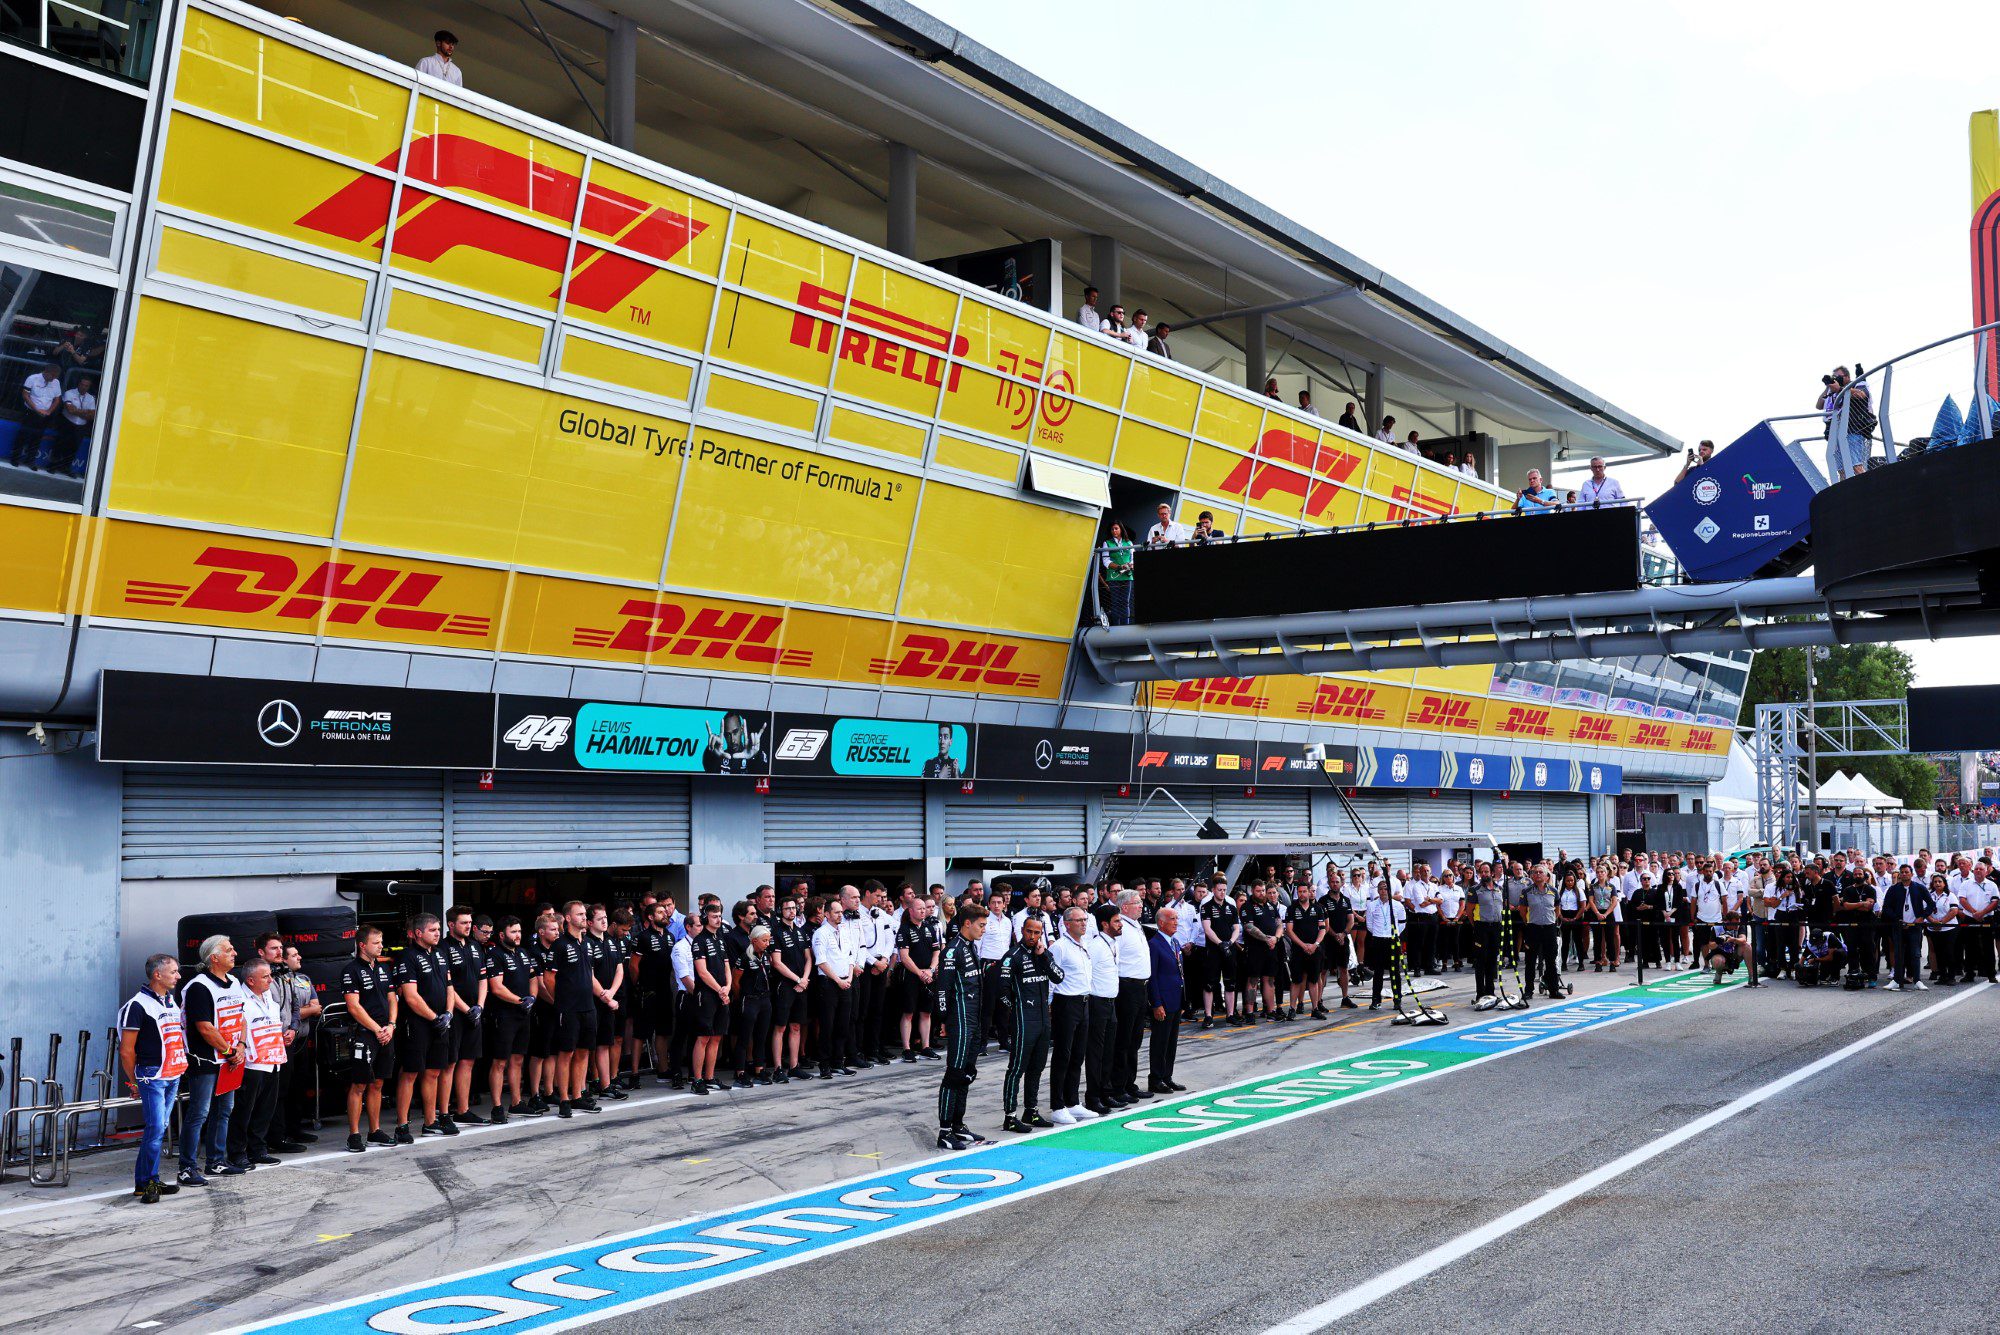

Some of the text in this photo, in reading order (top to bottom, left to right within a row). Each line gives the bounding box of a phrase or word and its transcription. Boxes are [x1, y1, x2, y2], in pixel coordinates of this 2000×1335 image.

[294, 133, 709, 313] F1
[629, 306, 651, 326] TM
[789, 281, 969, 393] PIRELLI
[1037, 427, 1064, 443] YEARS
[559, 409, 636, 446] Global
[643, 427, 694, 457] Tyre
[699, 439, 777, 475] Partner
[781, 462, 804, 481] of
[805, 464, 881, 498] Formula
[1219, 429, 1361, 517] F1
[1752, 483, 1774, 491] MONZA
[1752, 490, 1765, 500] 100
[1701, 525, 1715, 534] ACI
[180, 546, 447, 632] DHL
[608, 598, 786, 664] DHL
[893, 633, 1020, 687] DHL
[1172, 676, 1255, 709] DHL
[1308, 683, 1376, 719] DHL
[347, 710, 392, 721] AMG
[1415, 696, 1471, 728] DHL
[1503, 707, 1550, 736] DHL
[310, 720, 391, 732] PETRONAS
[322, 731, 391, 741] FORMULA ONE TEAM
[503, 714, 572, 752] 44
[591, 719, 632, 734] LEWIS
[1574, 715, 1614, 742] DHL
[1634, 723, 1668, 747] DHL
[585, 733, 699, 757] HAMILTON
[775, 728, 829, 761] 63
[850, 733, 888, 745] GEORGE
[1686, 729, 1715, 751] DHL
[845, 745, 911, 764] RUSSELL
[1056, 752, 1090, 760] PETRONAS
[1174, 755, 1189, 765] HOT
[1290, 759, 1302, 769] HOT
[479, 772, 492, 784] 12
[756, 778, 769, 789] 11
[962, 781, 974, 790] 10
[1120, 785, 1127, 793] 9
[1247, 786, 1252, 794] 8
[938, 990, 947, 1012] INEOS
[1123, 1059, 1430, 1134] aramco
[366, 1168, 1023, 1335] aramco
